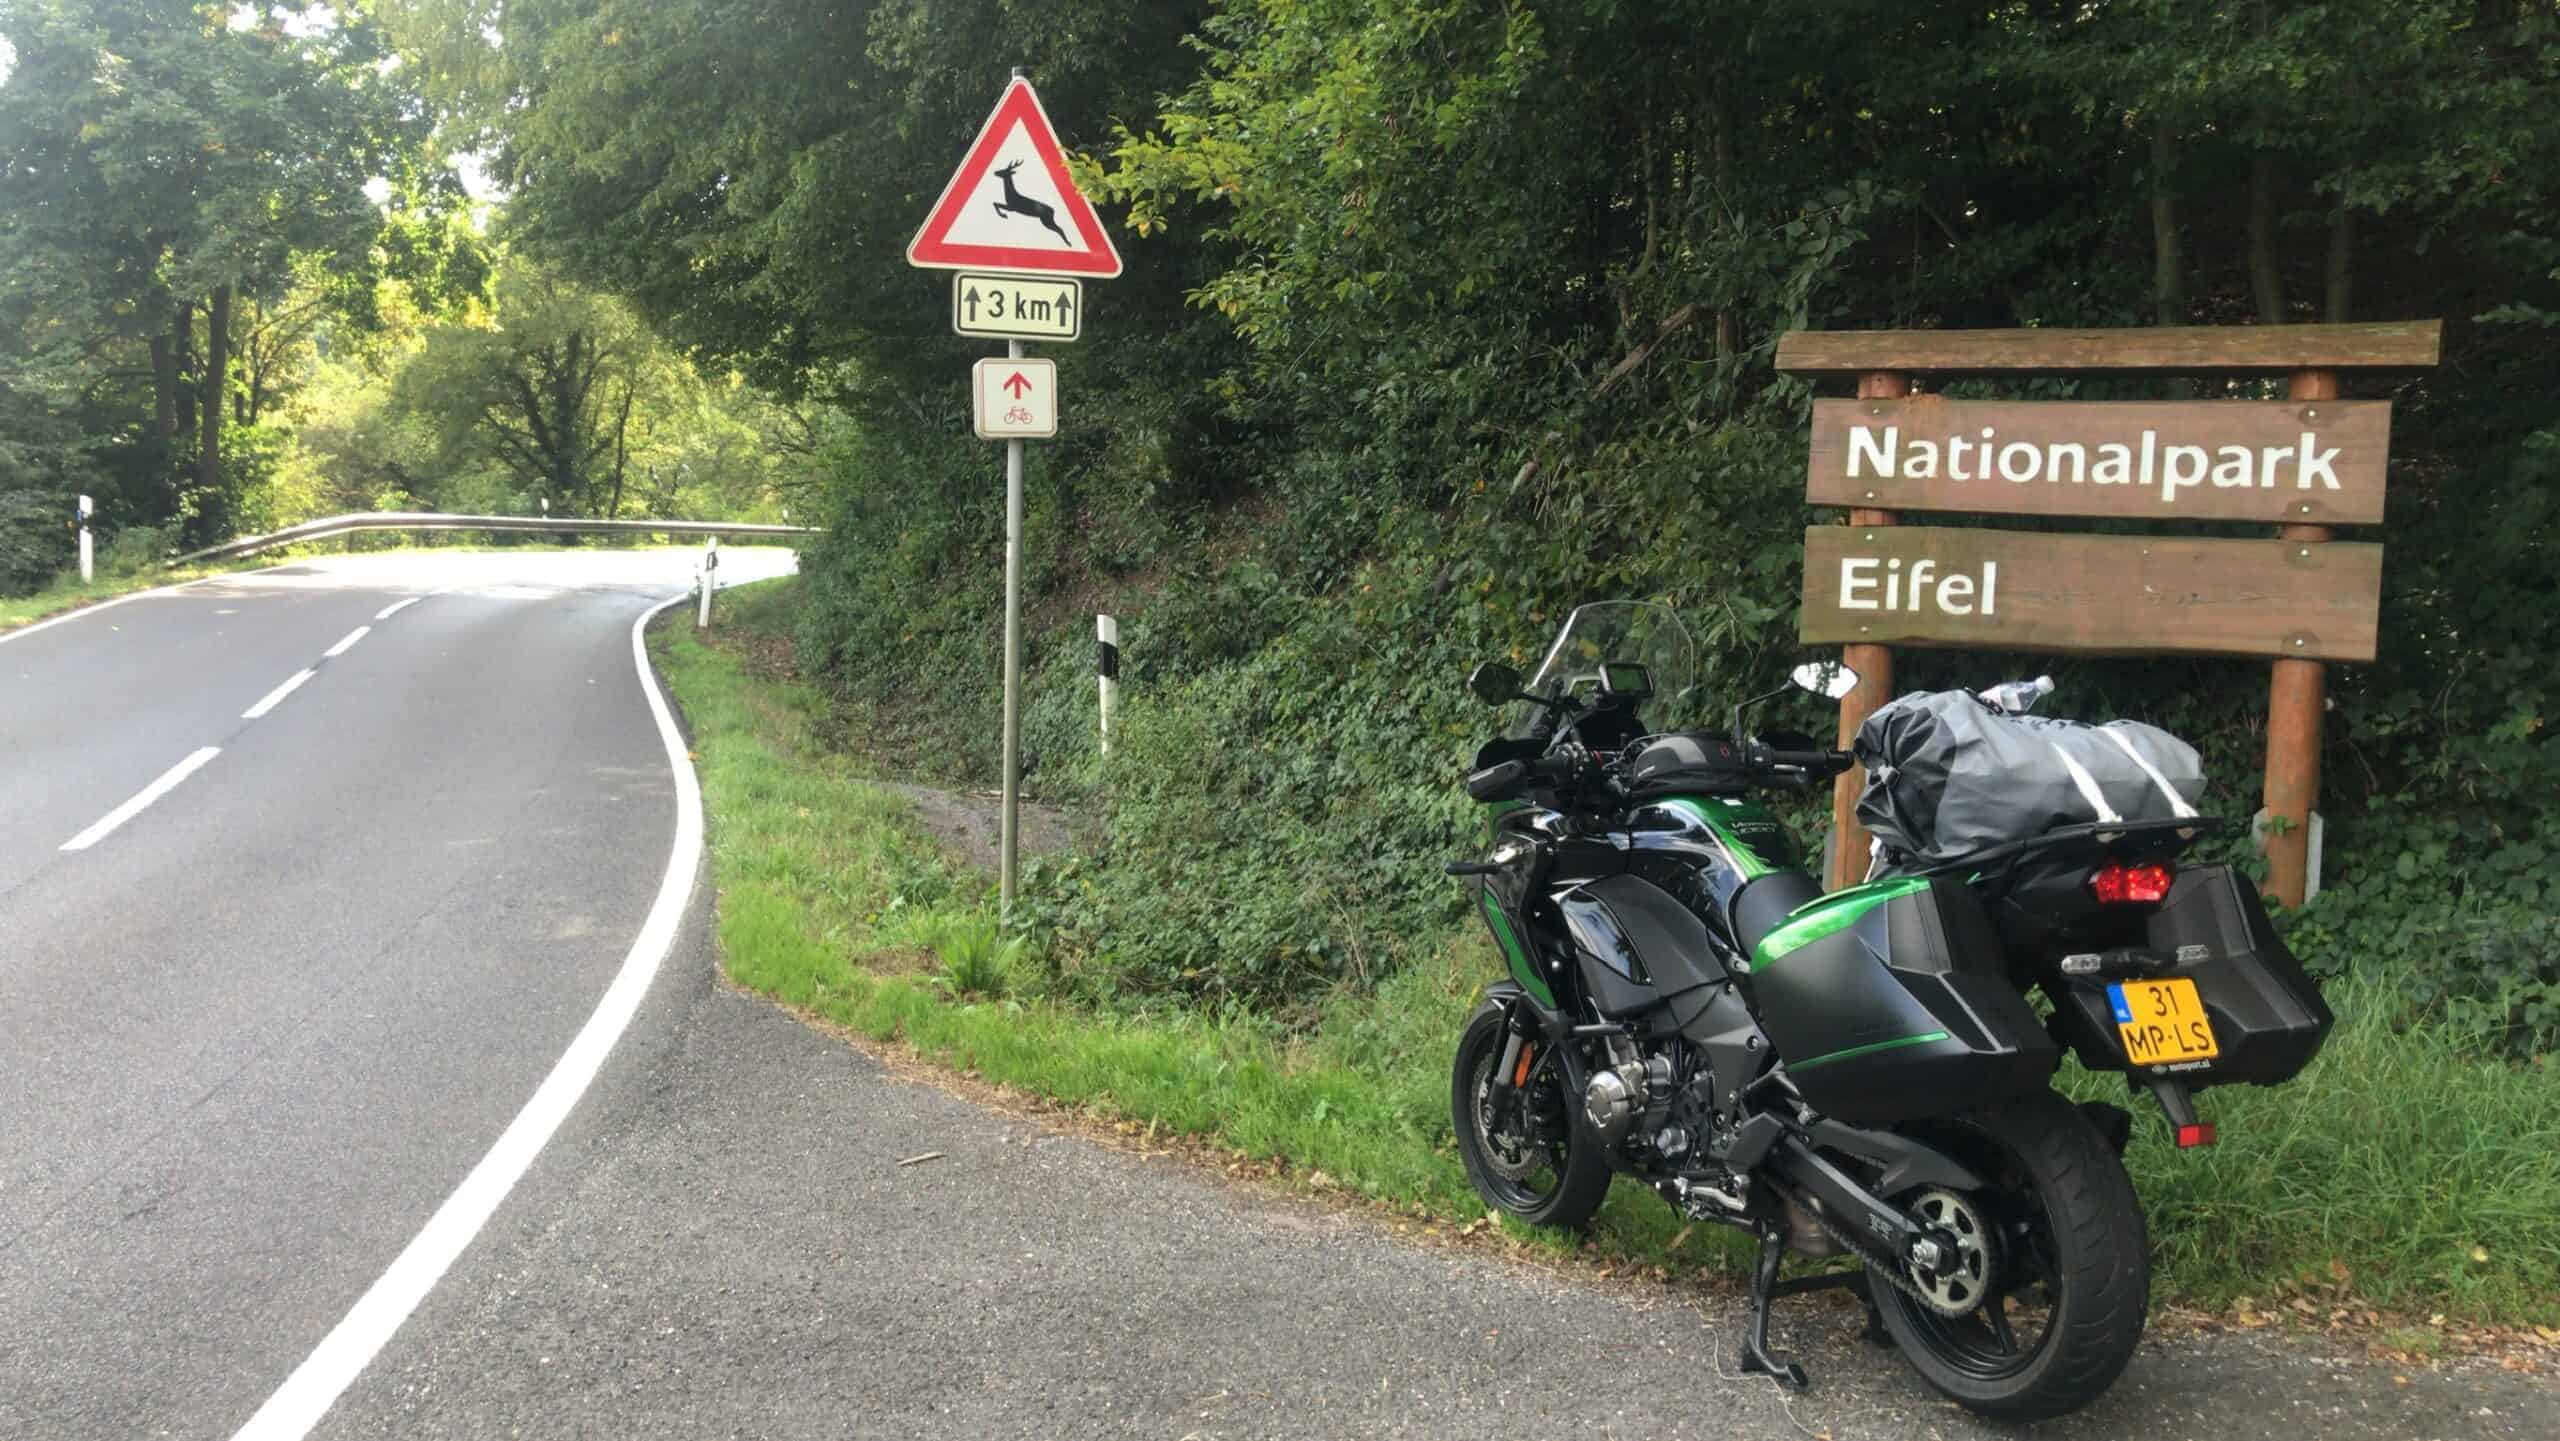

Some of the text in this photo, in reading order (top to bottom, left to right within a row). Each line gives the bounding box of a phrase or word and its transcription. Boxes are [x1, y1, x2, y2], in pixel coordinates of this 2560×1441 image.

[988, 290, 1052, 321] 3 km
[1846, 425, 2342, 503] Nationalpark
[1839, 557, 1997, 615] Eifel
[2148, 985, 2179, 1017] 31
